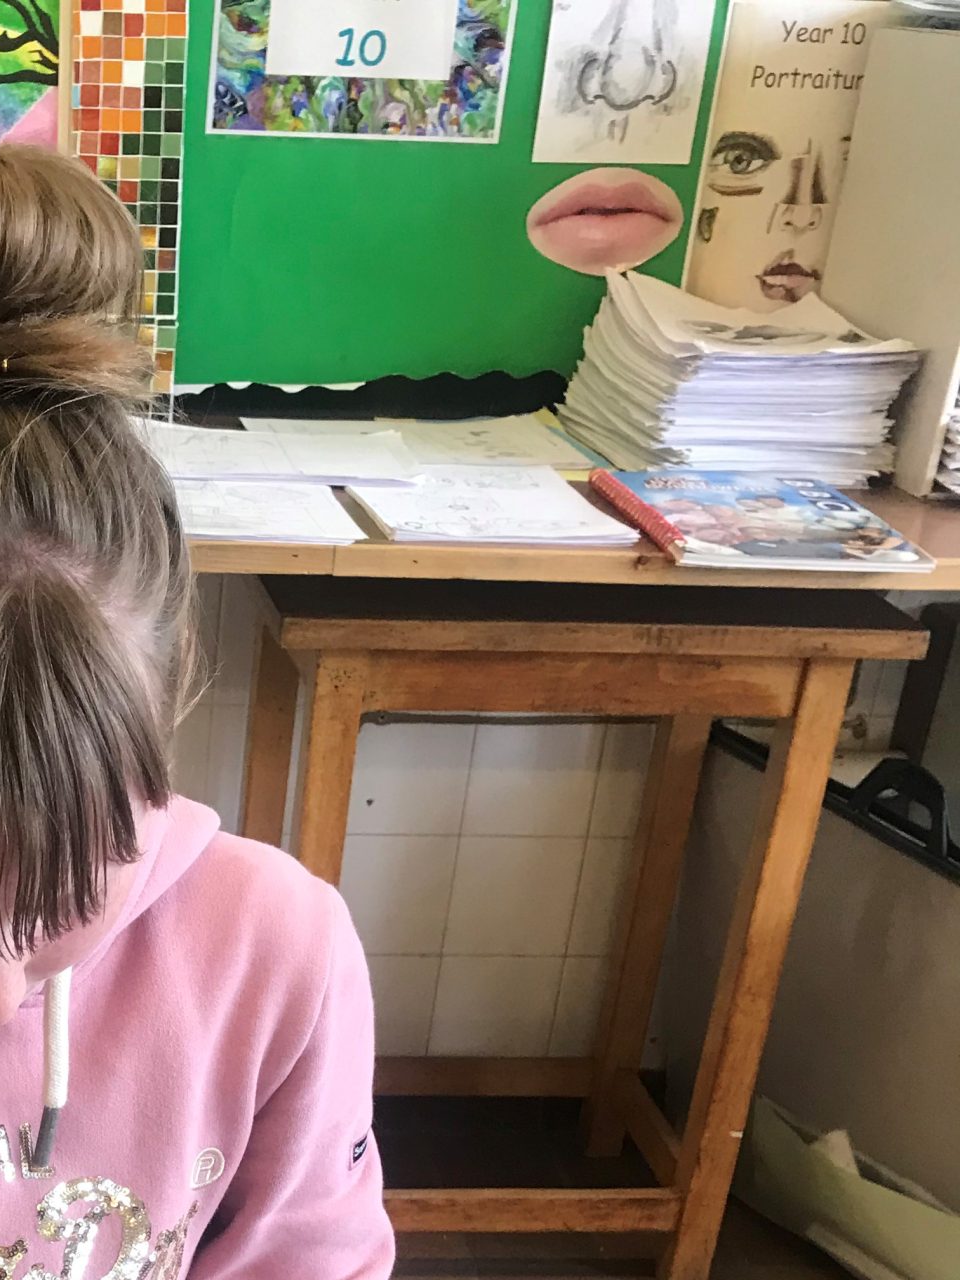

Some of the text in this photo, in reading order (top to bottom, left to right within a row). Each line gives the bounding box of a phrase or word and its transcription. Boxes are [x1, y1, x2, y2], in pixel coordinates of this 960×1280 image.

[335, 27, 387, 67] 10
[782, 20, 867, 46] Year 10
